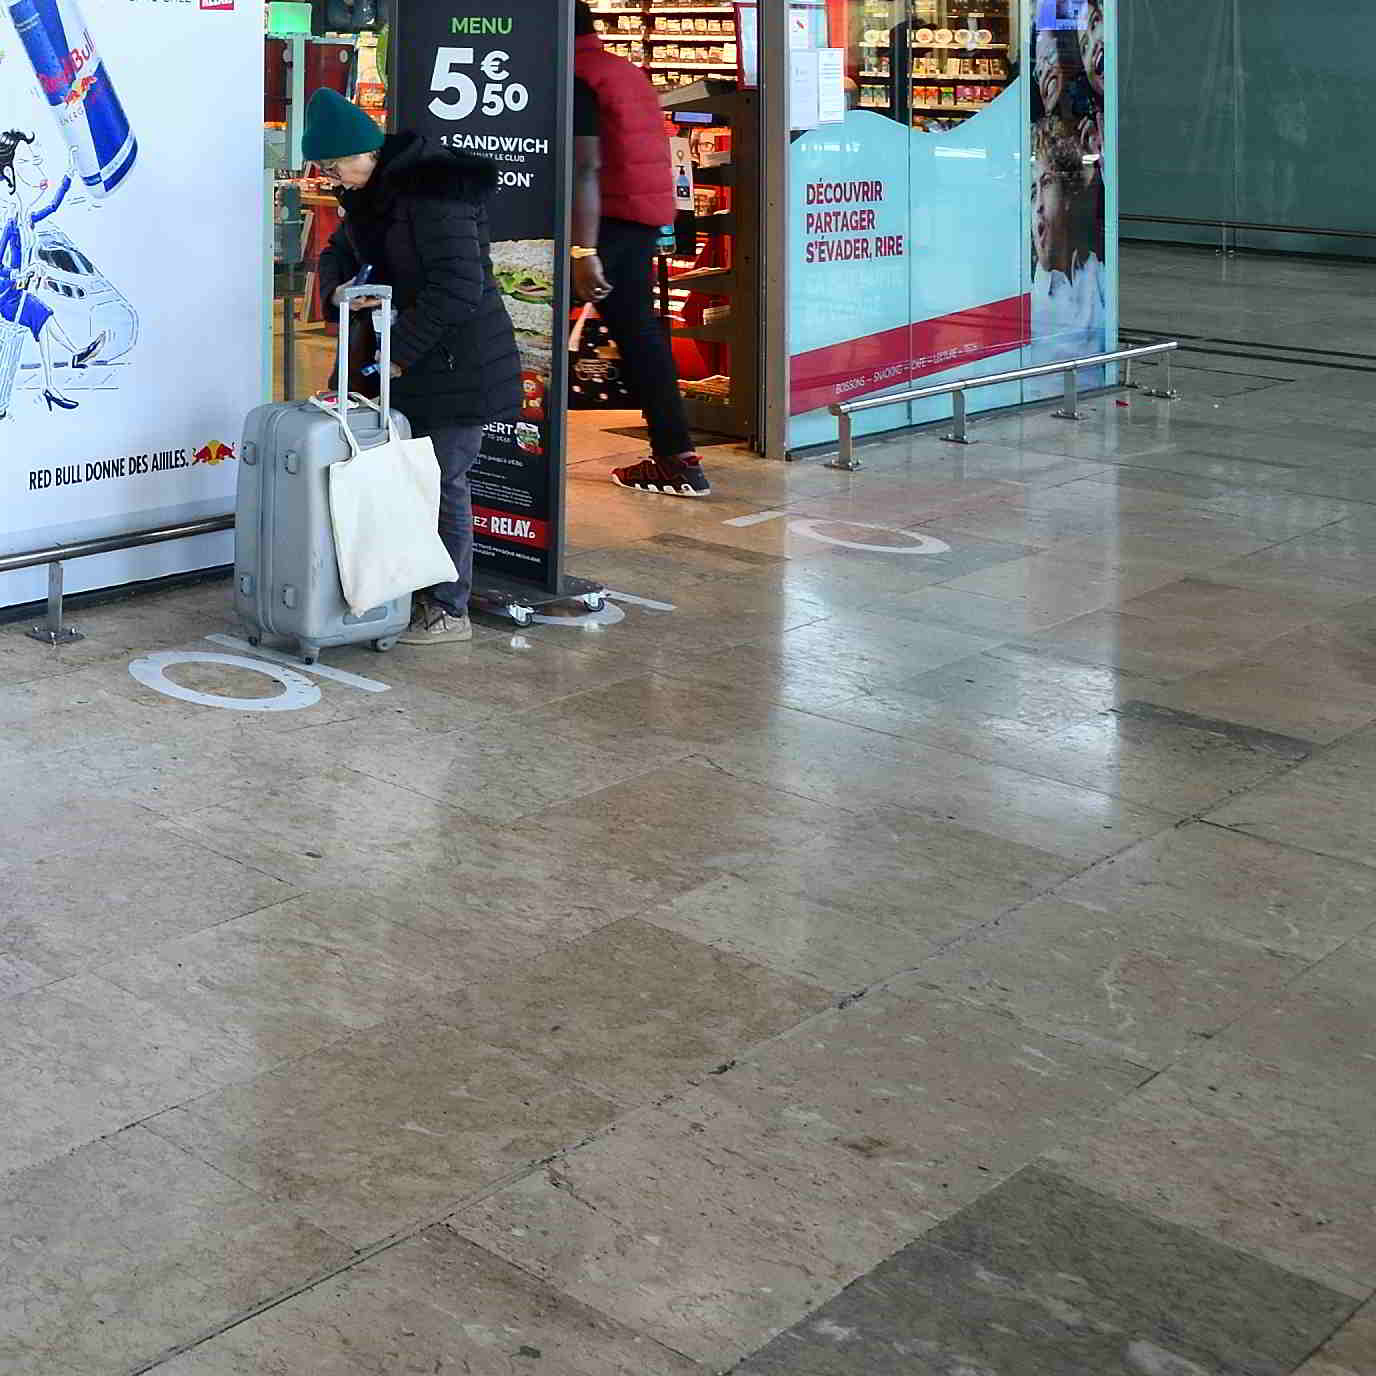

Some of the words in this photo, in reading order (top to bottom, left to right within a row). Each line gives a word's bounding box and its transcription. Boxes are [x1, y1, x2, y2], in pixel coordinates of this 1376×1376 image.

[451, 17, 513, 34] MENU
[452, 133, 548, 154] SANDWICH
[806, 178, 883, 205] DÉCOUVRIR
[806, 209, 876, 234] PARTAGER
[806, 235, 873, 263] S'ÉVADER,
[875, 235, 903, 257] RIRE
[29, 468, 52, 491] RED
[55, 464, 82, 487] BULL
[85, 458, 125, 484] DONNE
[128, 455, 148, 476] DES
